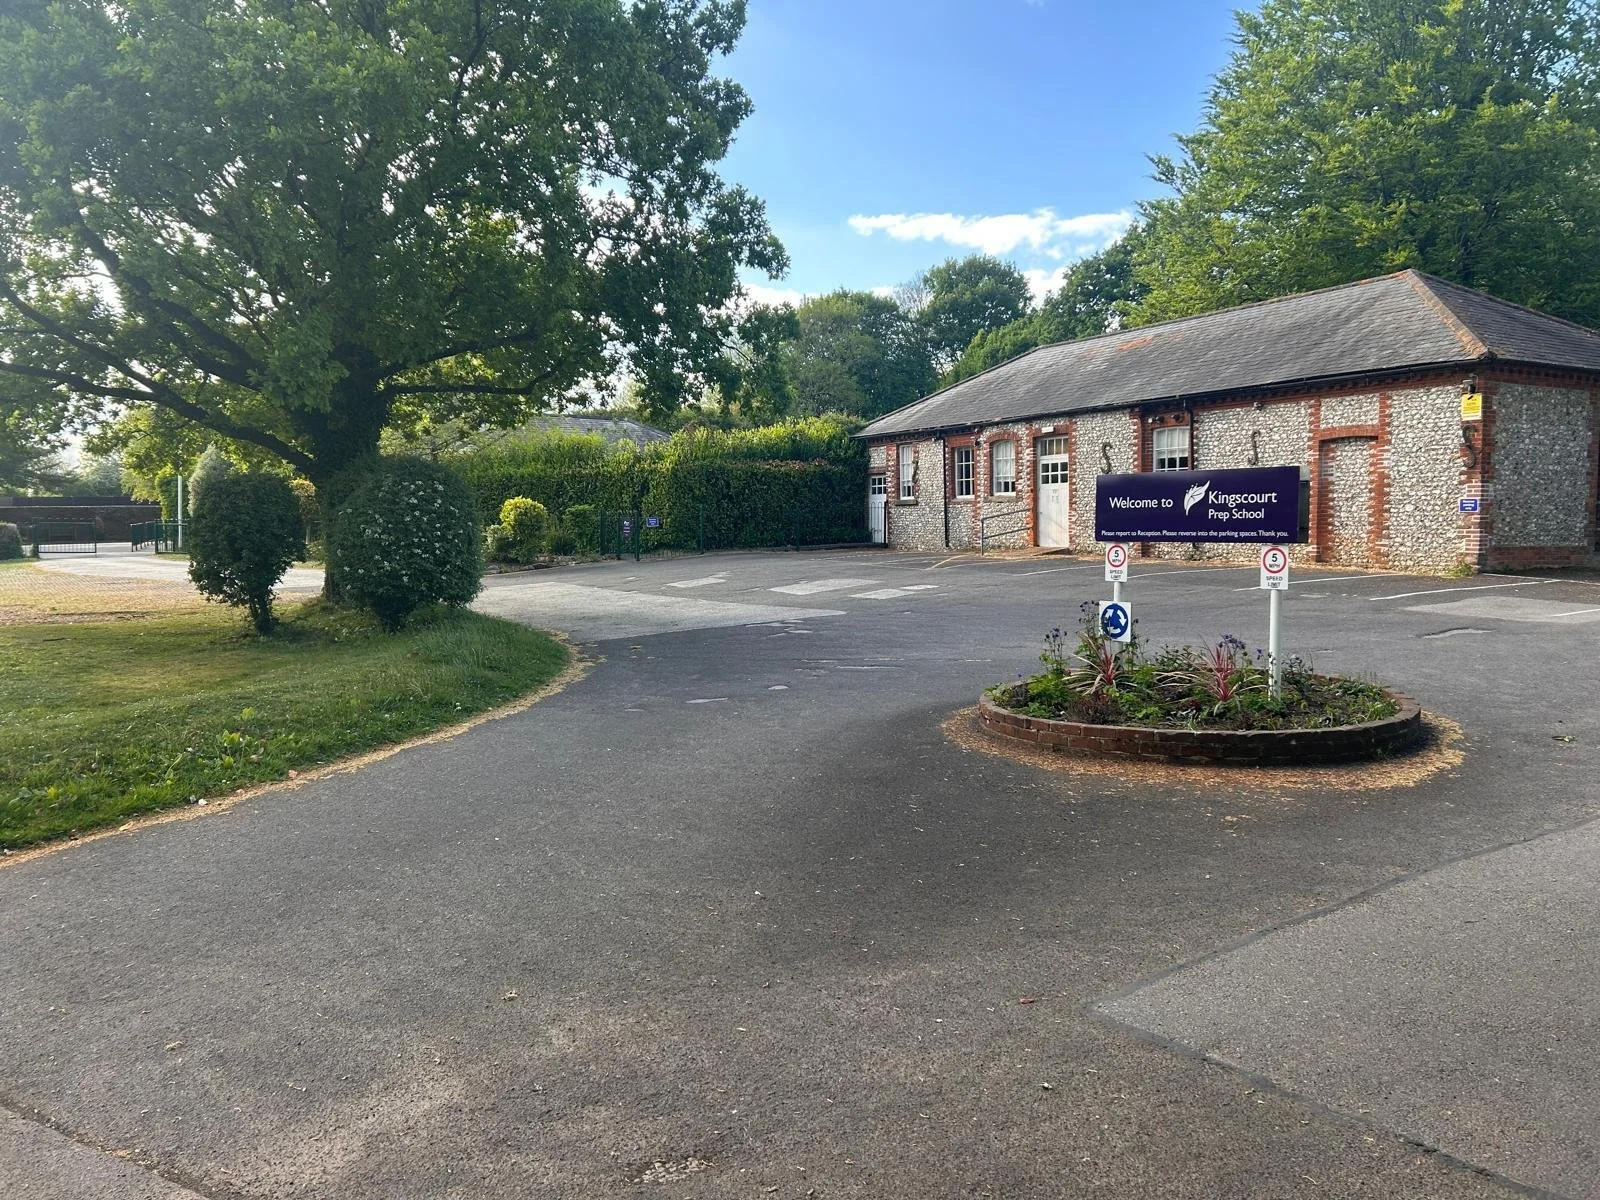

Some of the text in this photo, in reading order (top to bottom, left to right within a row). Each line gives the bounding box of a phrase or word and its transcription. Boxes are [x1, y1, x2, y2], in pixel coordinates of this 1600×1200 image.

[1109, 497, 1174, 509] Welcome to
[1208, 491, 1277, 507] Kingscourt
[1208, 508, 1265, 522] Prep School
[1218, 530, 1239, 538] parking
[1114, 550, 1120, 558] 5
[1271, 553, 1278, 563] 5
